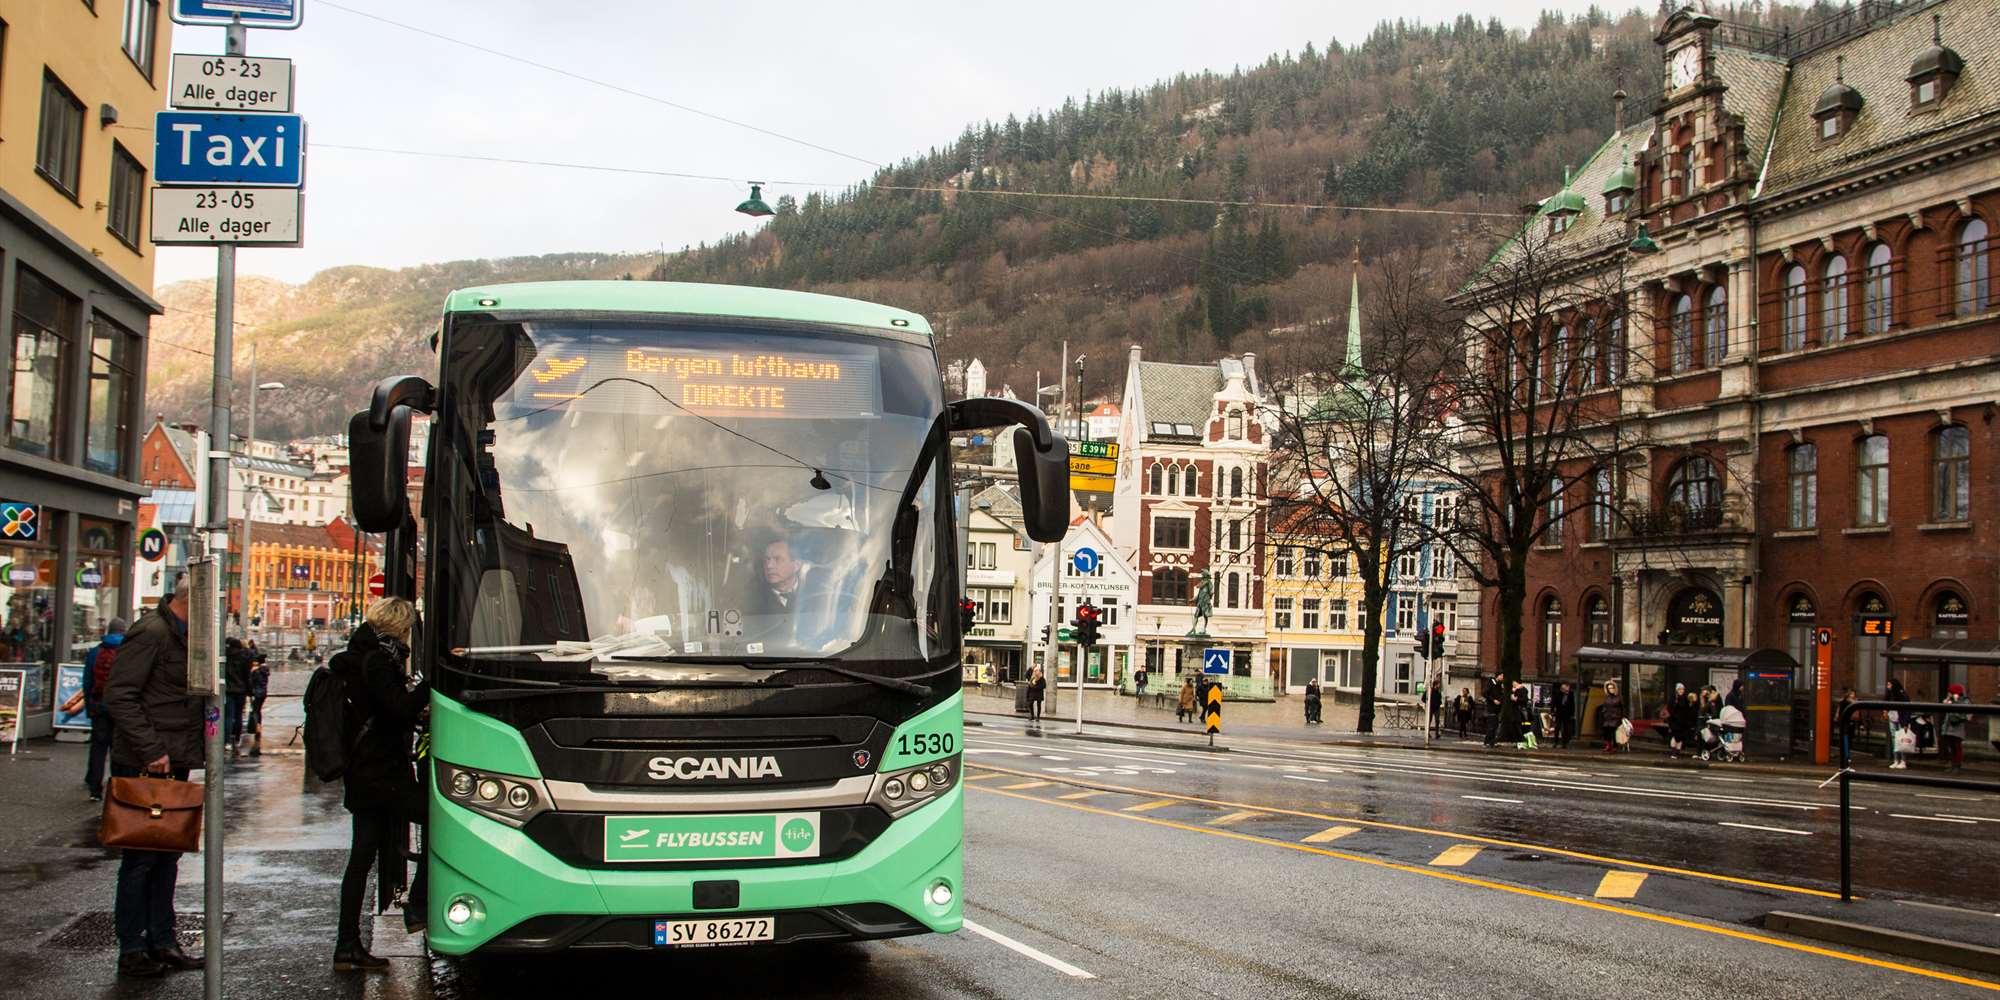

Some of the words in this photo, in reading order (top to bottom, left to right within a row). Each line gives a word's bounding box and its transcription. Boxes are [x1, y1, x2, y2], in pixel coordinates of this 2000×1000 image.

[183, 84, 215, 100] Alle
[226, 87, 277, 105] dager
[172, 123, 285, 167] Taxi
[178, 218, 210, 233] Alle
[220, 218, 271, 237] dager
[626, 350, 722, 379] Bergen
[732, 355, 840, 380] lufthavn
[683, 384, 785, 409] DIREKTE
[1070, 462, 1090, 470] sane
[144, 537, 160, 552] N
[1681, 616, 1720, 624] KAFFELADE
[1821, 632, 1828, 643] N
[897, 733, 954, 755] 1530
[648, 756, 783, 780] SCANIA
[656, 831, 764, 848] FLYBUSSEN
[784, 828, 811, 840] tide
[672, 924, 697, 941] SV
[707, 920, 768, 940] 86272
